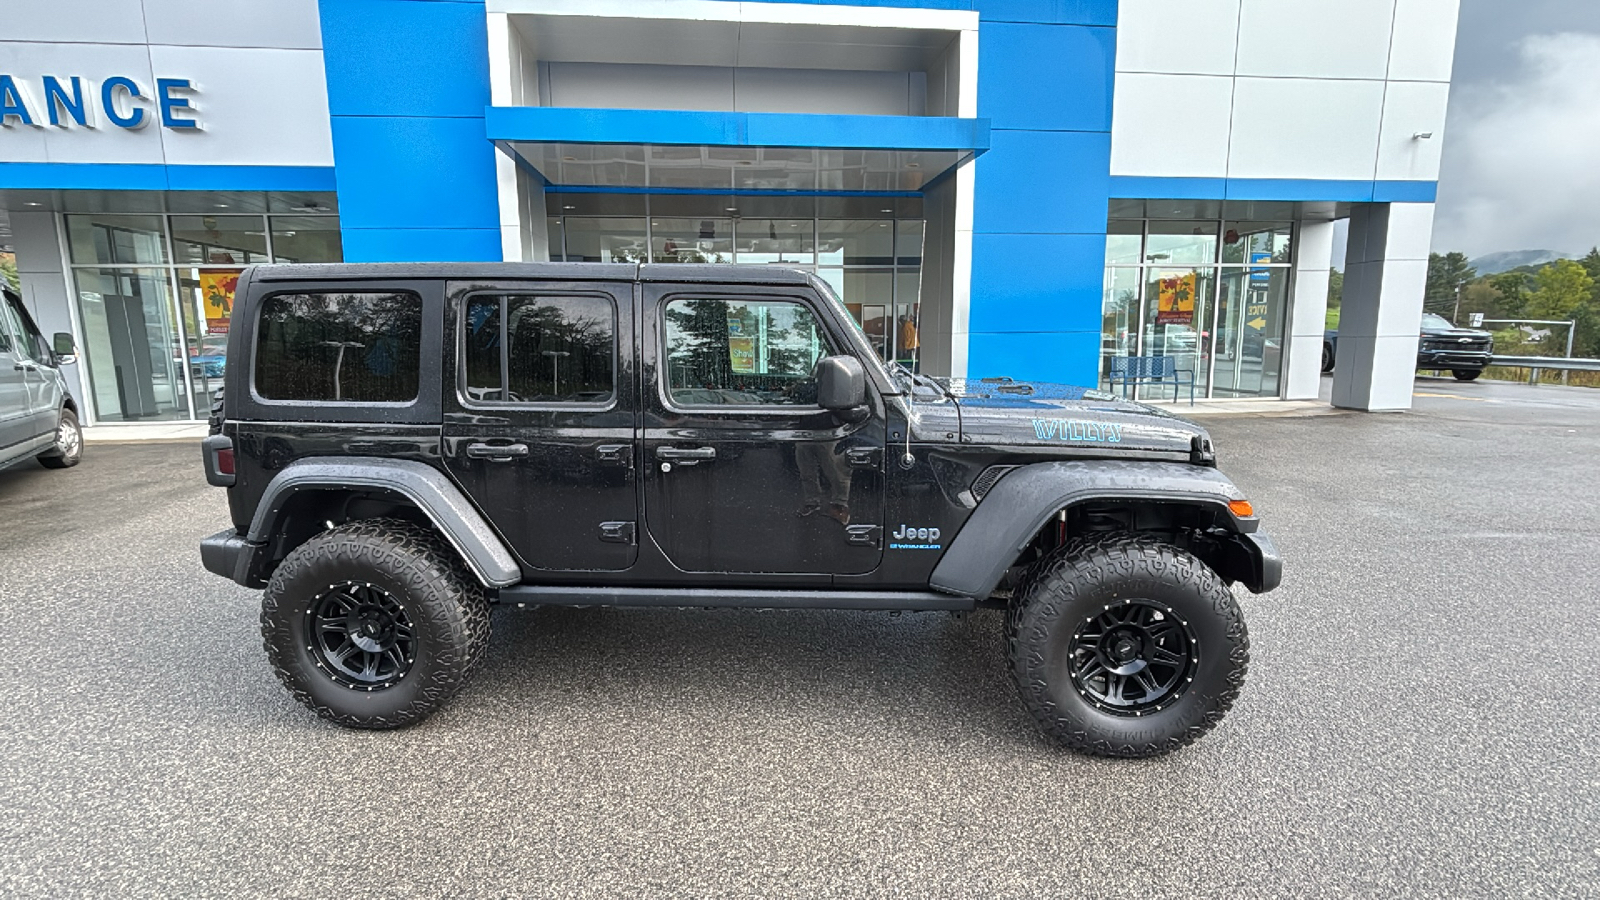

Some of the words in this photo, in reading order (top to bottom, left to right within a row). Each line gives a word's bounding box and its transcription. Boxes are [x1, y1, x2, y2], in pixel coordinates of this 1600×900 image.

[0, 74, 197, 129] ANCE
[1032, 419, 1122, 443] WILLYS
[892, 524, 941, 544] Jeep
